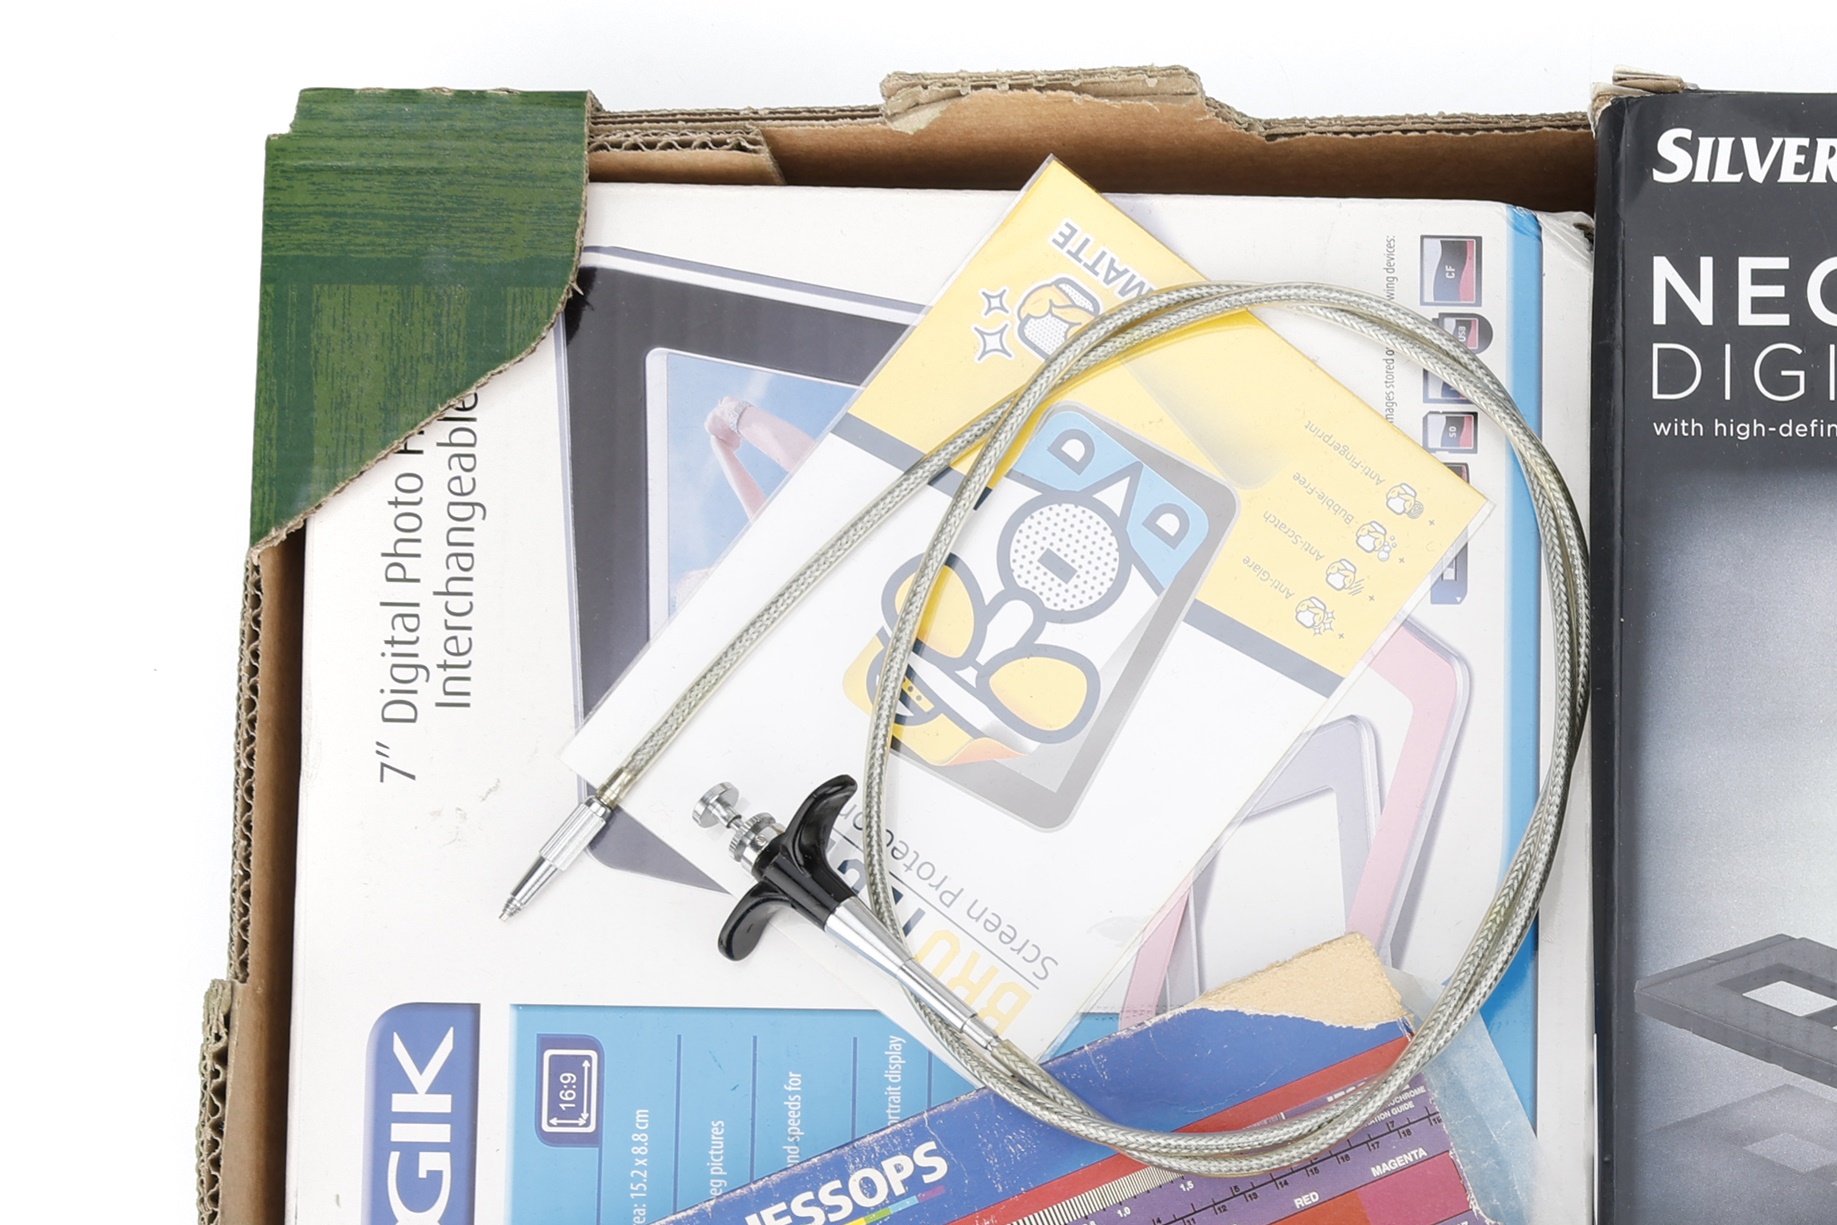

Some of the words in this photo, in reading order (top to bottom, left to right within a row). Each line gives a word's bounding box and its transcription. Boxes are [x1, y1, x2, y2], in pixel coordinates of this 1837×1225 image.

[1384, 236, 1396, 271] devices:
[1445, 265, 1456, 279] CF
[1383, 359, 1395, 388] stored
[1385, 389, 1398, 423] mages
[1449, 426, 1457, 438] SD
[1653, 419, 1704, 438] with
[1304, 420, 1385, 486] Anti-Fingerprint
[1292, 472, 1355, 525] Bubble-Free
[380, 471, 424, 583] Photo
[1263, 510, 1325, 562] Anti-Scratch
[433, 392, 488, 709] Interchangeable
[1242, 556, 1295, 600] Anti-Glare
[380, 589, 430, 724] Digital
[840, 803, 964, 908] Protecor
[967, 898, 1059, 982] Screen
[884, 1035, 906, 1082] display
[559, 1072, 577, 1111] 16:9
[784, 1071, 801, 1093] for
[636, 1108, 649, 1130] cm
[783, 1096, 805, 1141] speeds
[885, 1084, 902, 1126] ortrait
[631, 1133, 649, 1156] 8.8
[707, 1120, 727, 1175] pictures
[630, 1170, 648, 1199] 15.2
[1293, 1191, 1320, 1210] RED
[1371, 1146, 1428, 1178] MAGENTA
